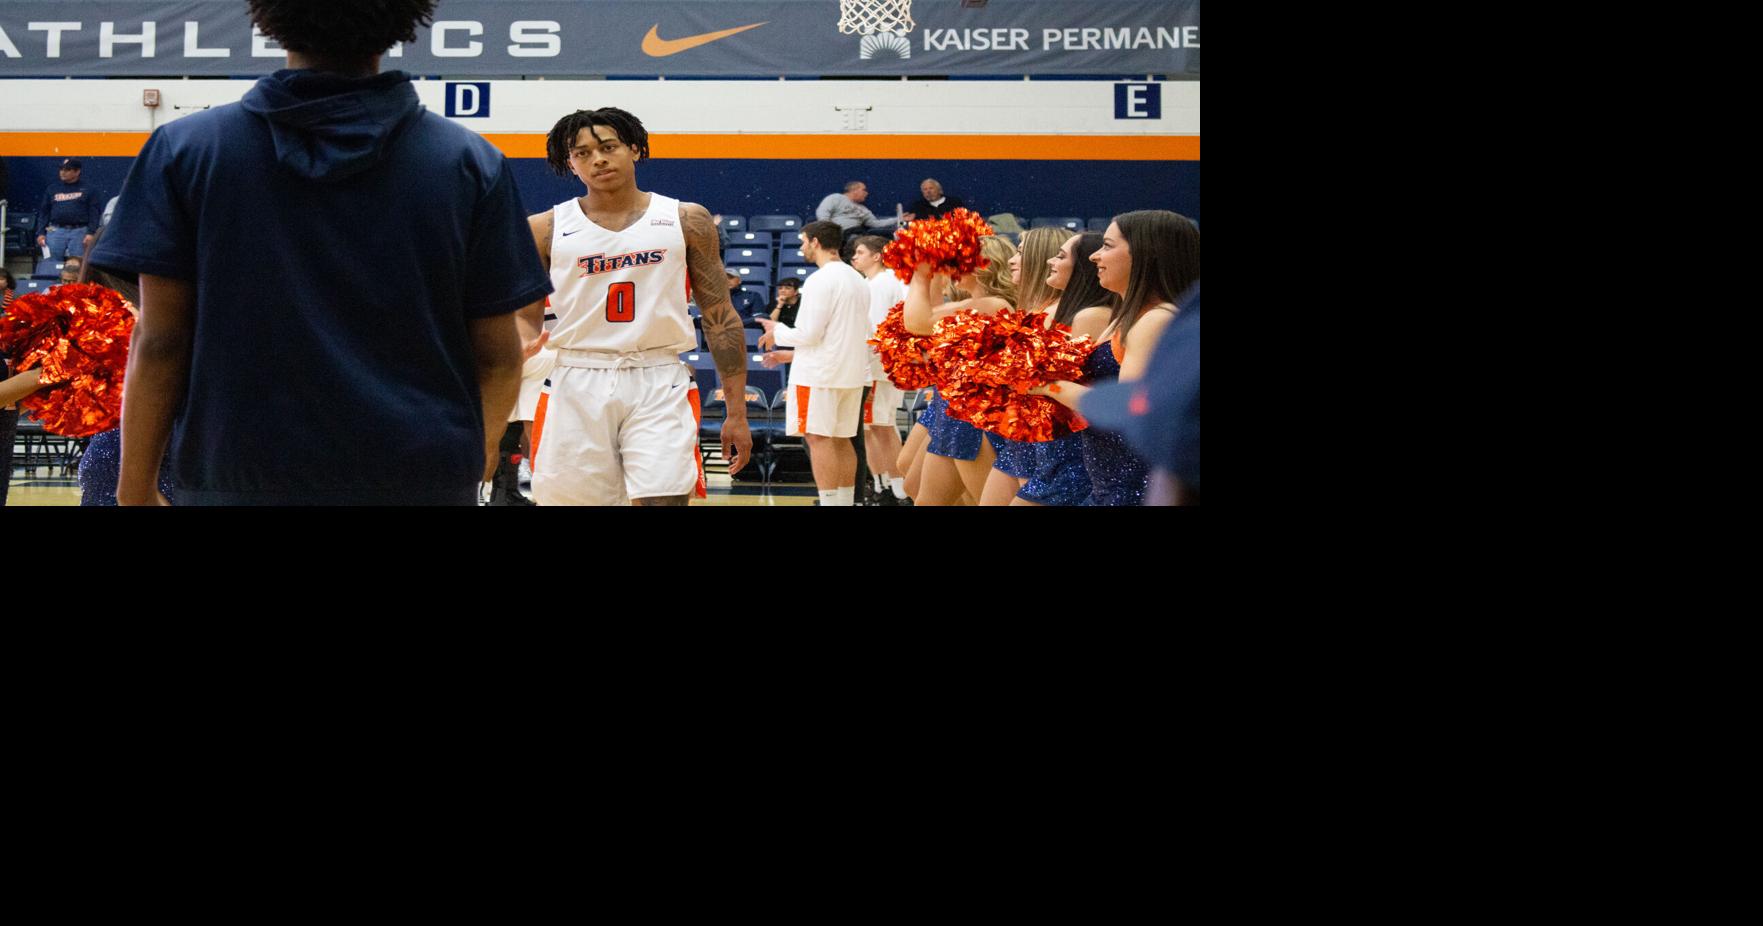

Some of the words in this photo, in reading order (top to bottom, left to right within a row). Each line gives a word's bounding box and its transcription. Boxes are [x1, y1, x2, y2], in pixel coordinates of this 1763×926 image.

[923, 28, 1030, 51] KAISER
[1042, 26, 1200, 50] PERMANE
[455, 84, 480, 116] D
[1127, 85, 1148, 117] E
[578, 249, 666, 276] TITANS
[606, 282, 635, 323] 0
